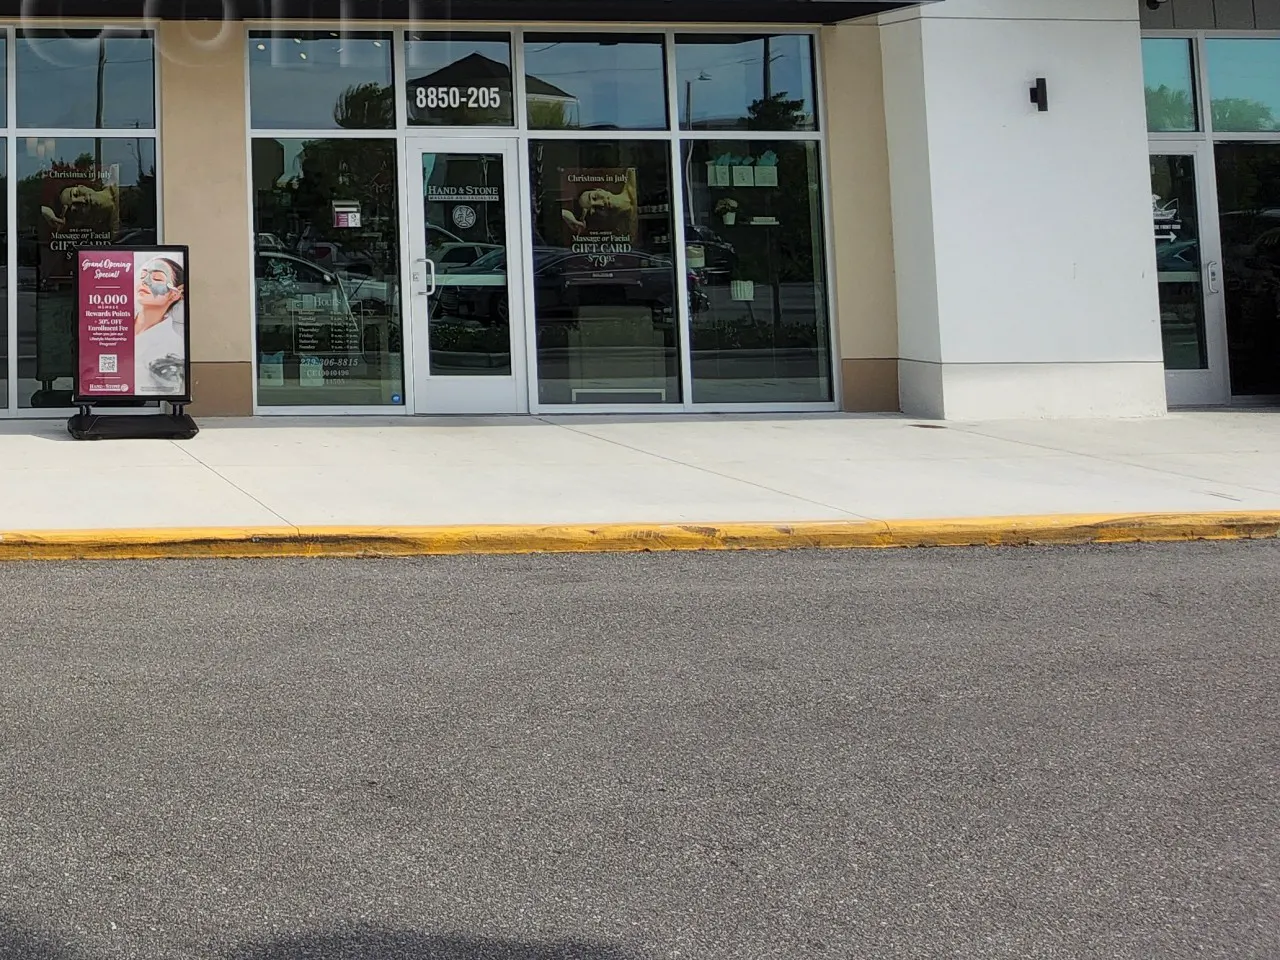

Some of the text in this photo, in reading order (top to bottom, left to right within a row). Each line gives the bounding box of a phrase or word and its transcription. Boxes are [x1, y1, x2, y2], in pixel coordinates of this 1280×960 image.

[416, 86, 501, 109] 8850-205
[50, 170, 88, 178] Christmas
[614, 174, 628, 183] July
[428, 186, 457, 194] HAND
[466, 186, 498, 194] STONE
[51, 232, 80, 240] Massage
[572, 243, 631, 253] GIFT CARD
[82, 259, 132, 272] Grand Opening
